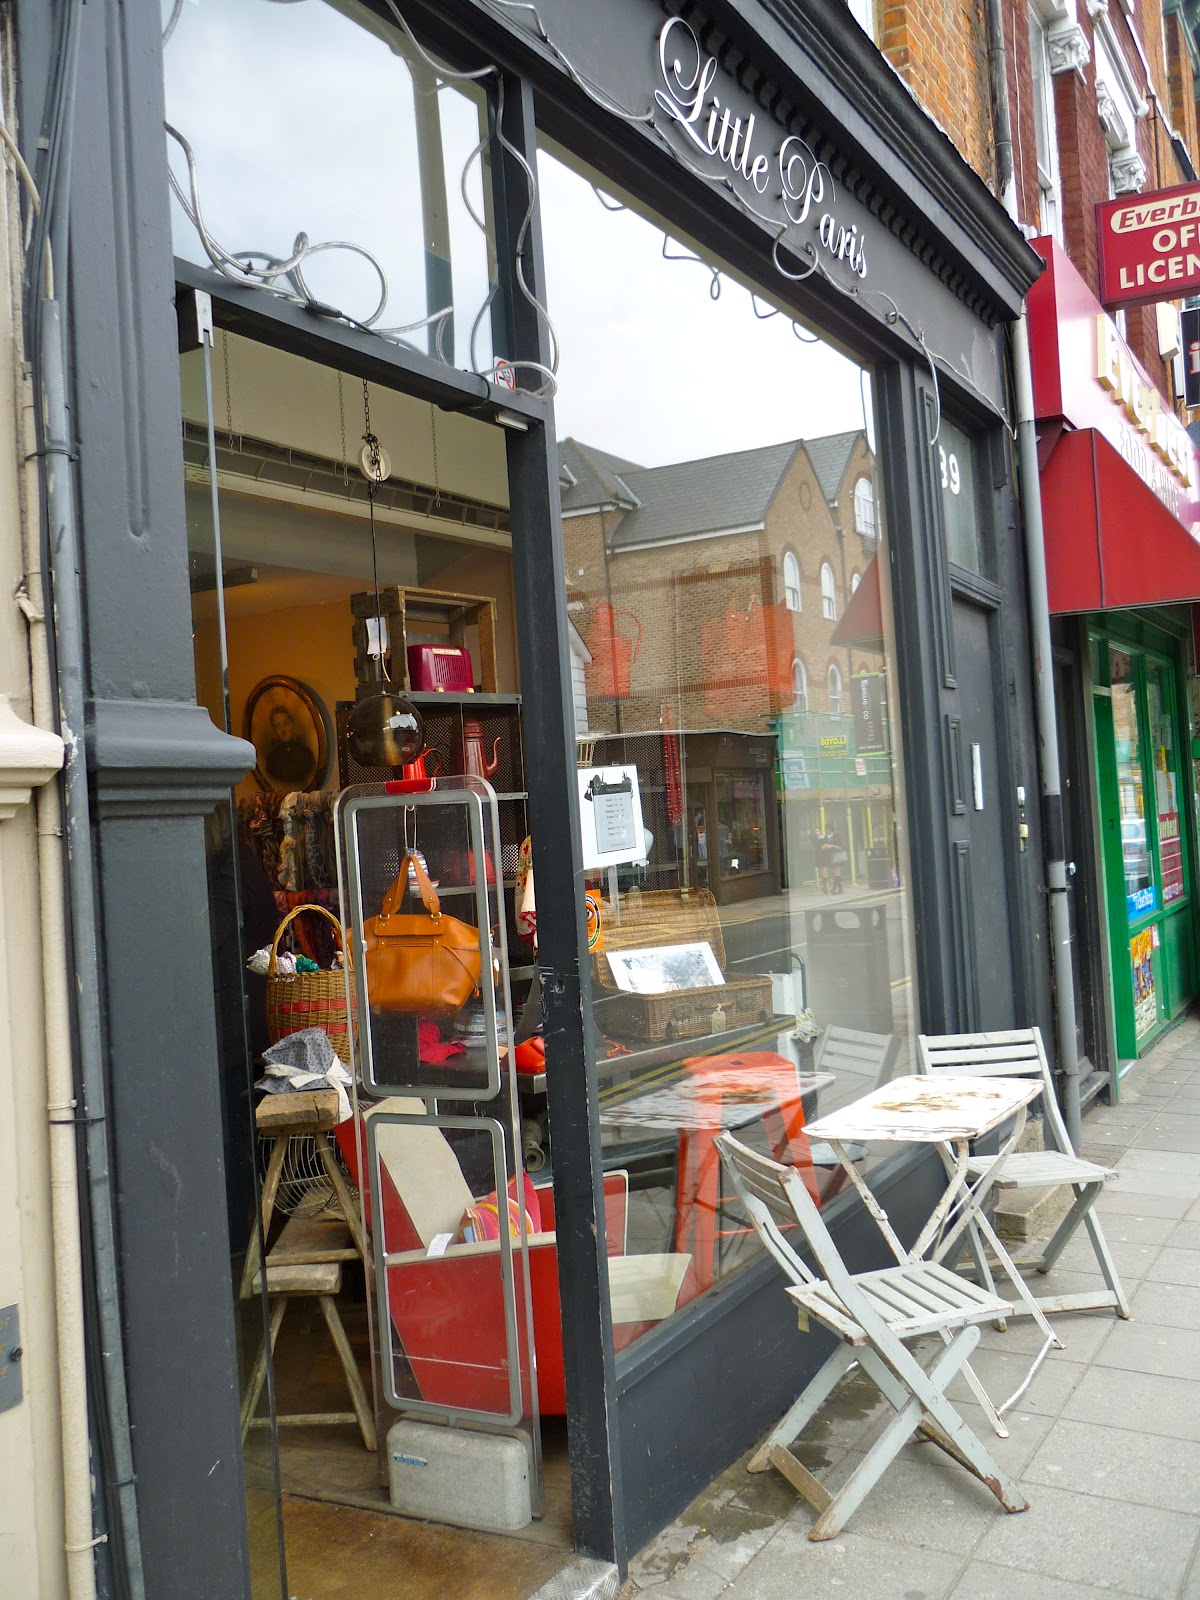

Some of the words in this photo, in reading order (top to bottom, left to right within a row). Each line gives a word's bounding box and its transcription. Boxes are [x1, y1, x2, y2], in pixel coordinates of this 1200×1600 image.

[654, 17, 770, 193] Little
[779, 136, 867, 278] Paris
[1118, 197, 1200, 229] Everb
[1152, 222, 1200, 253] OF
